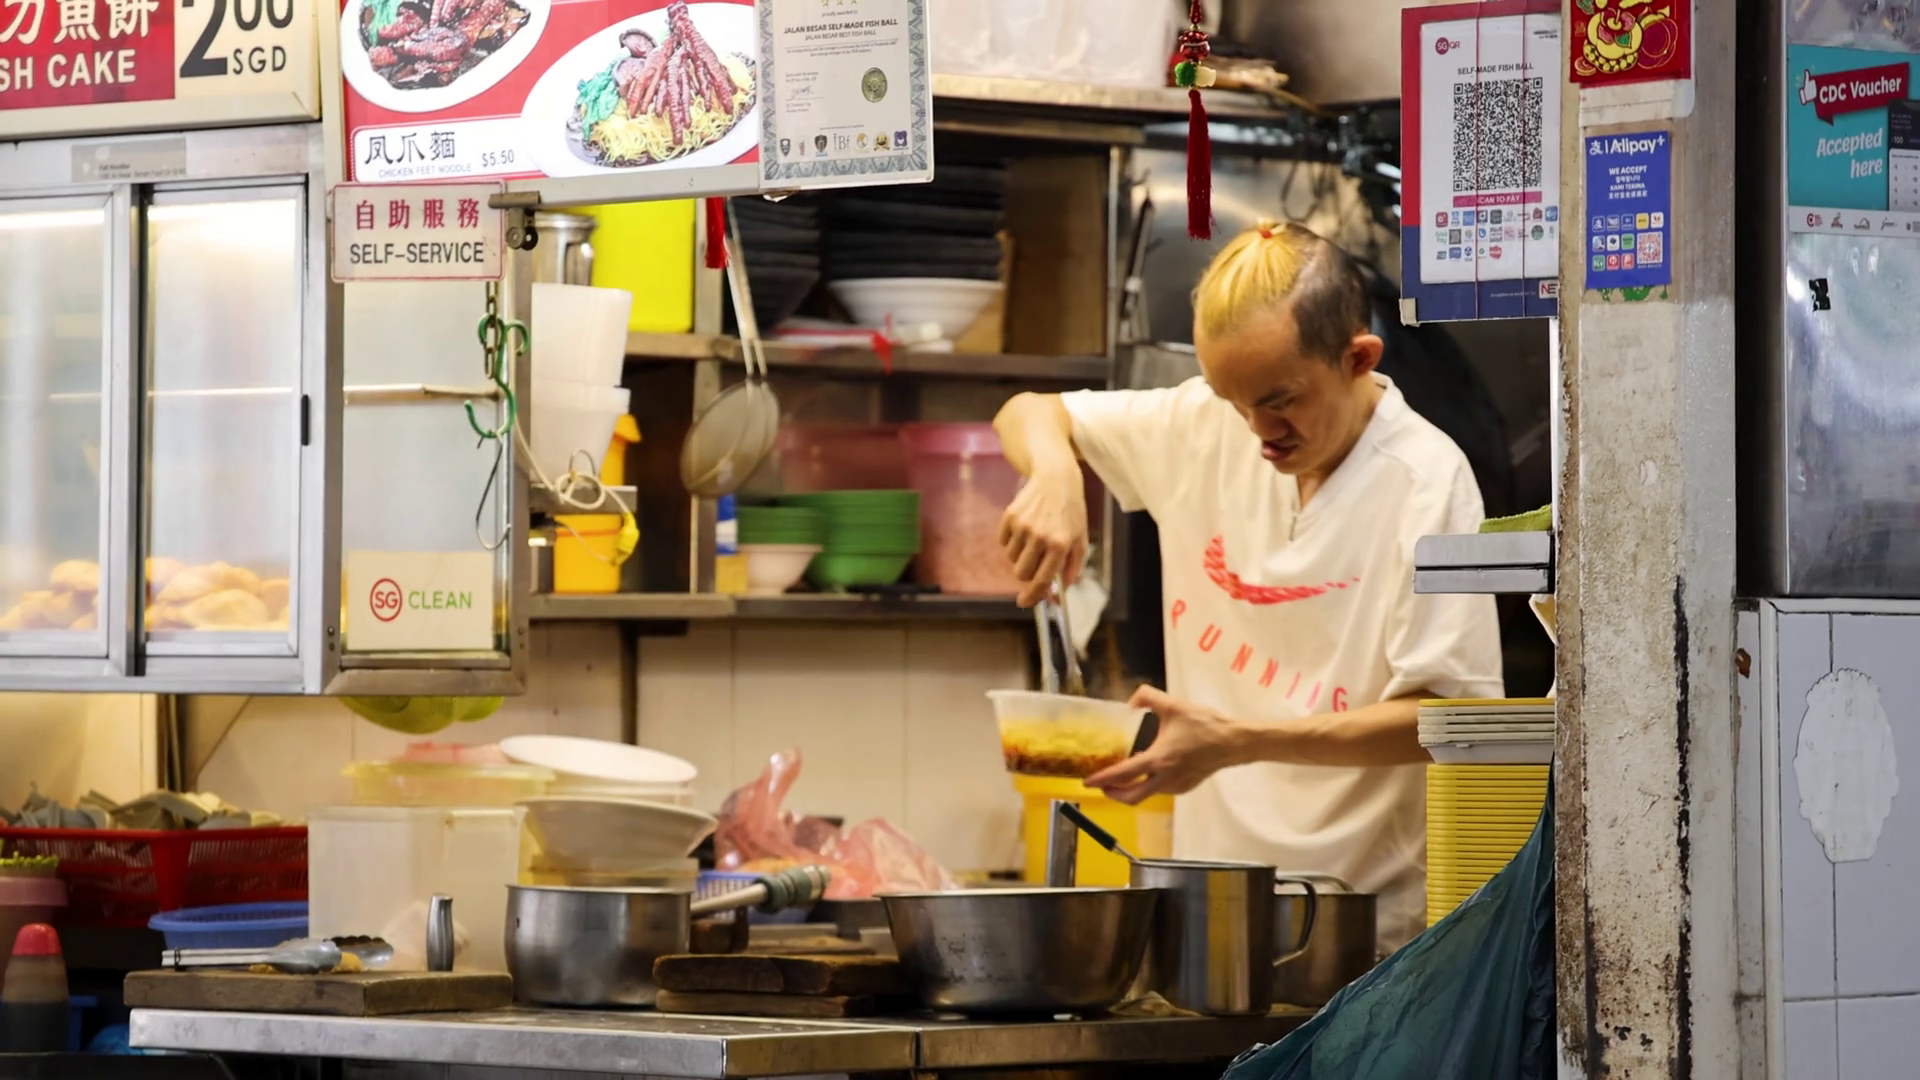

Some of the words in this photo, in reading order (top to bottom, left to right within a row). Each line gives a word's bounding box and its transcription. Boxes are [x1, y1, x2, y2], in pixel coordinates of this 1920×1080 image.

[784, 26, 805, 35] JALAN
[806, 24, 827, 33] BESAR
[828, 21, 864, 30] SELF-MADE
[865, 20, 880, 28] FISH
[881, 18, 898, 26] BALL
[805, 33, 821, 41] JALAN
[822, 31, 838, 39] BESAR
[47, 48, 137, 88] CAKE
[232, 45, 287, 75] SGD
[1457, 63, 1497, 75] SELF-MADE
[1498, 64, 1514, 72] FISH
[1515, 62, 1534, 71] BALL
[1819, 83, 1847, 104] CDC
[1850, 76, 1902, 99] Voucher
[1816, 127, 1883, 158] Accepted
[481, 149, 515, 168] $5.50
[1850, 157, 1883, 178] here
[378, 167, 414, 179] CHICKEN
[416, 165, 435, 175] FEET
[438, 162, 472, 174] NOODLE
[1608, 167, 1620, 176] WE
[1620, 165, 1647, 175] ACCEPT
[1506, 195, 1520, 203] PAY
[356, 198, 480, 230] 自助服務
[350, 241, 484, 264] SELF-SERVICE
[374, 591, 399, 609] SG
[408, 591, 472, 609] CLEAN
